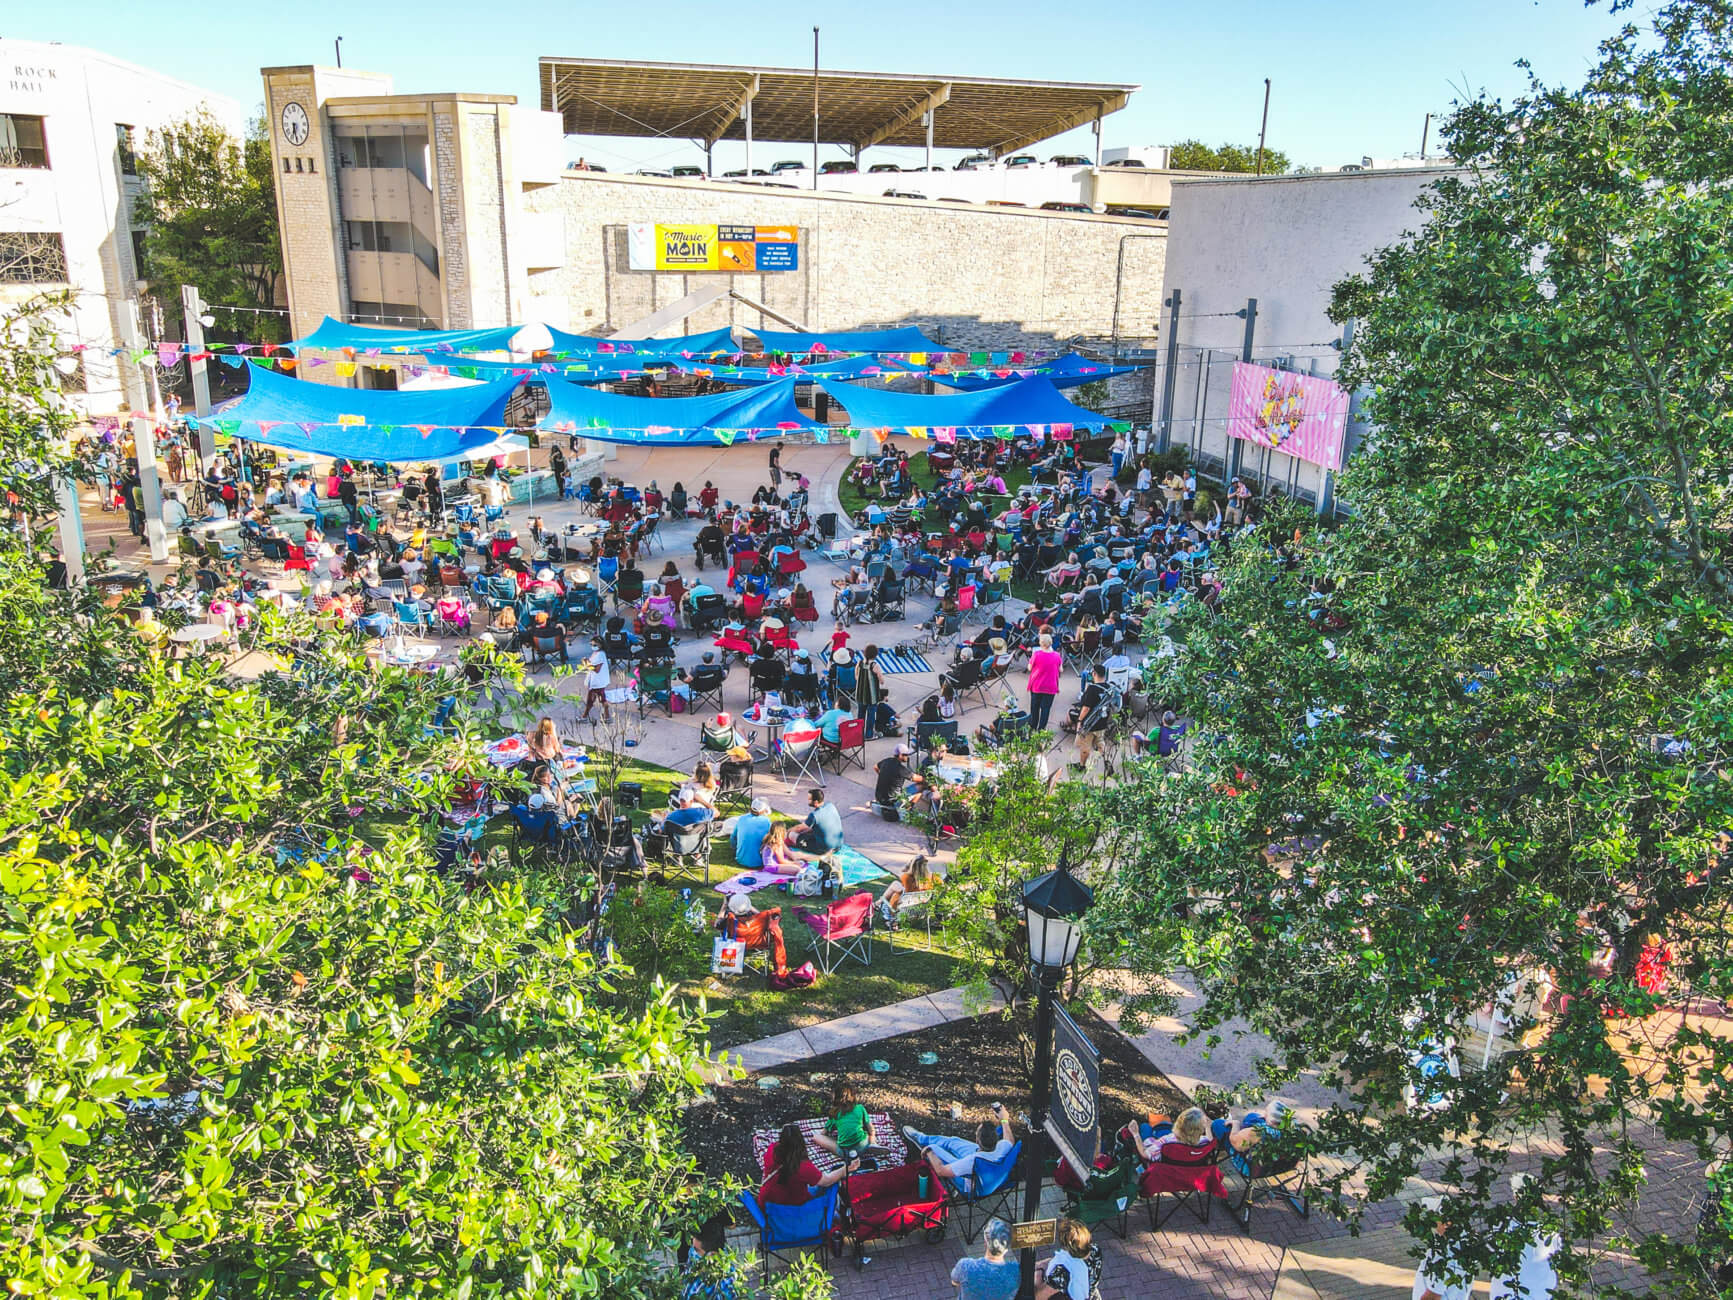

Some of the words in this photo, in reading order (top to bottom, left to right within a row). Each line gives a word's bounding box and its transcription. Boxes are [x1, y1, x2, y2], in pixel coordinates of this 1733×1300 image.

[15, 65, 57, 80] ROCK
[671, 231, 703, 243] Music
[1059, 1066, 1092, 1115] DOWNTOWN
